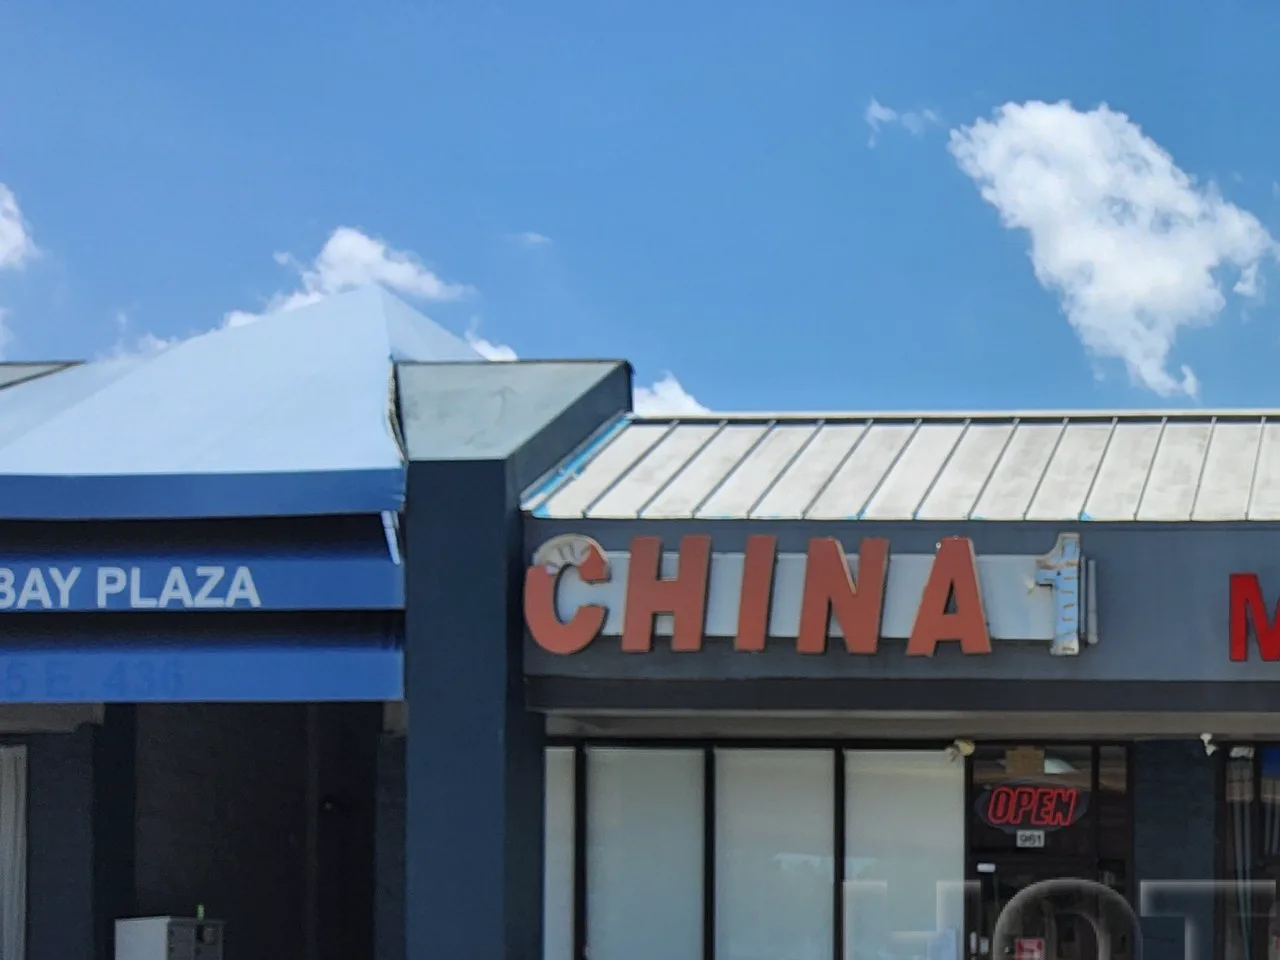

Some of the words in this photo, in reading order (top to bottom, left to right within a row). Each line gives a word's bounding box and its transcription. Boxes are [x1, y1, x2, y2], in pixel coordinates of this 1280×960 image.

[0, 566, 81, 609] BAY
[97, 566, 261, 609] PLAZA
[524, 532, 992, 656] CHINA
[1035, 532, 1081, 656] 1
[988, 785, 1078, 826] OPEN
